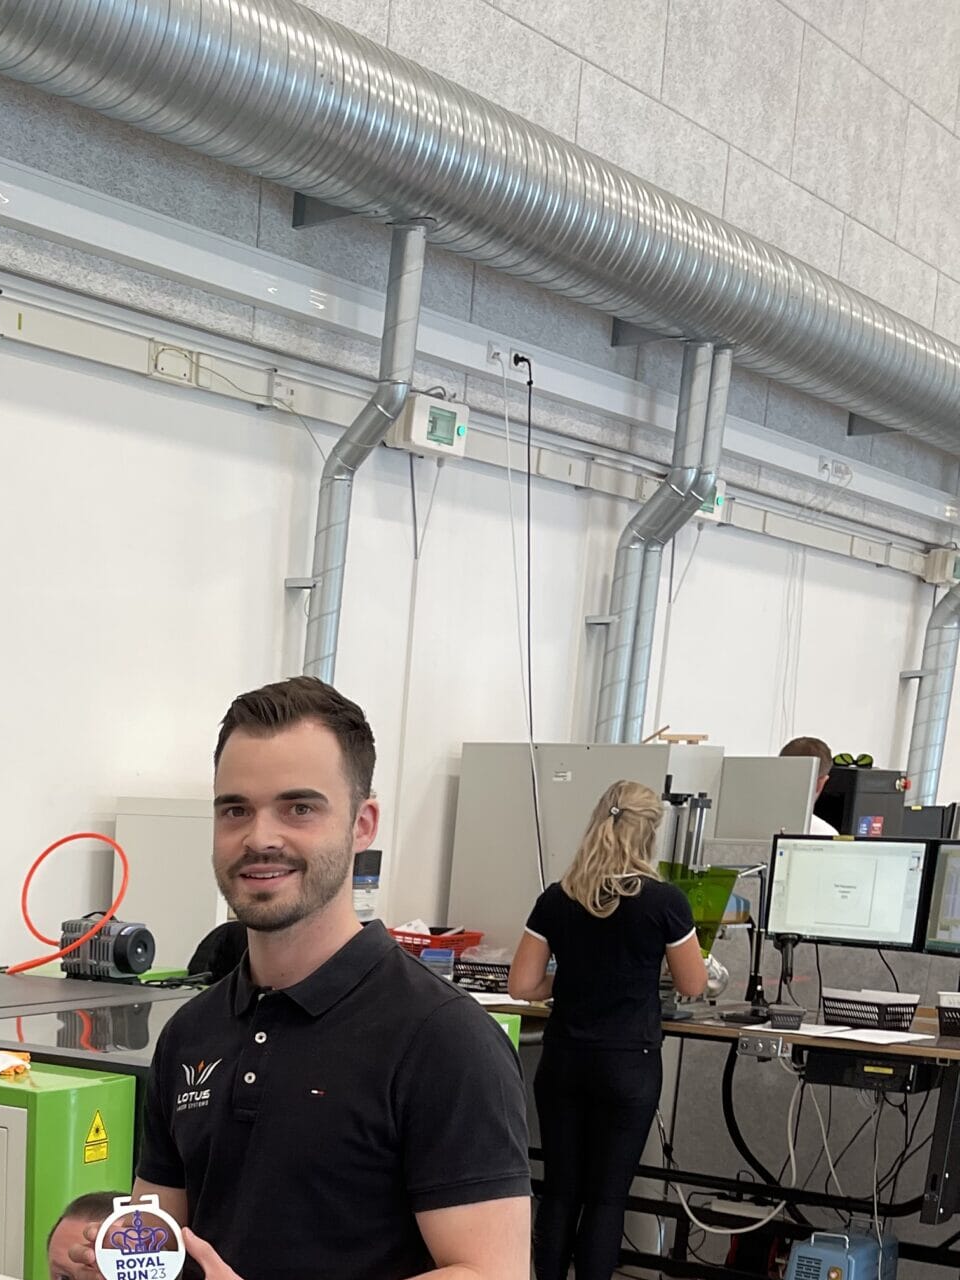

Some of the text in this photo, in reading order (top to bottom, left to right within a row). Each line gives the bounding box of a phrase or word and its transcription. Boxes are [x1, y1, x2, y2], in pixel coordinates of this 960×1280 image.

[177, 1089, 211, 1104] LOTUS
[116, 1256, 165, 1270] ROYAL
[150, 1268, 167, 1279] 23
